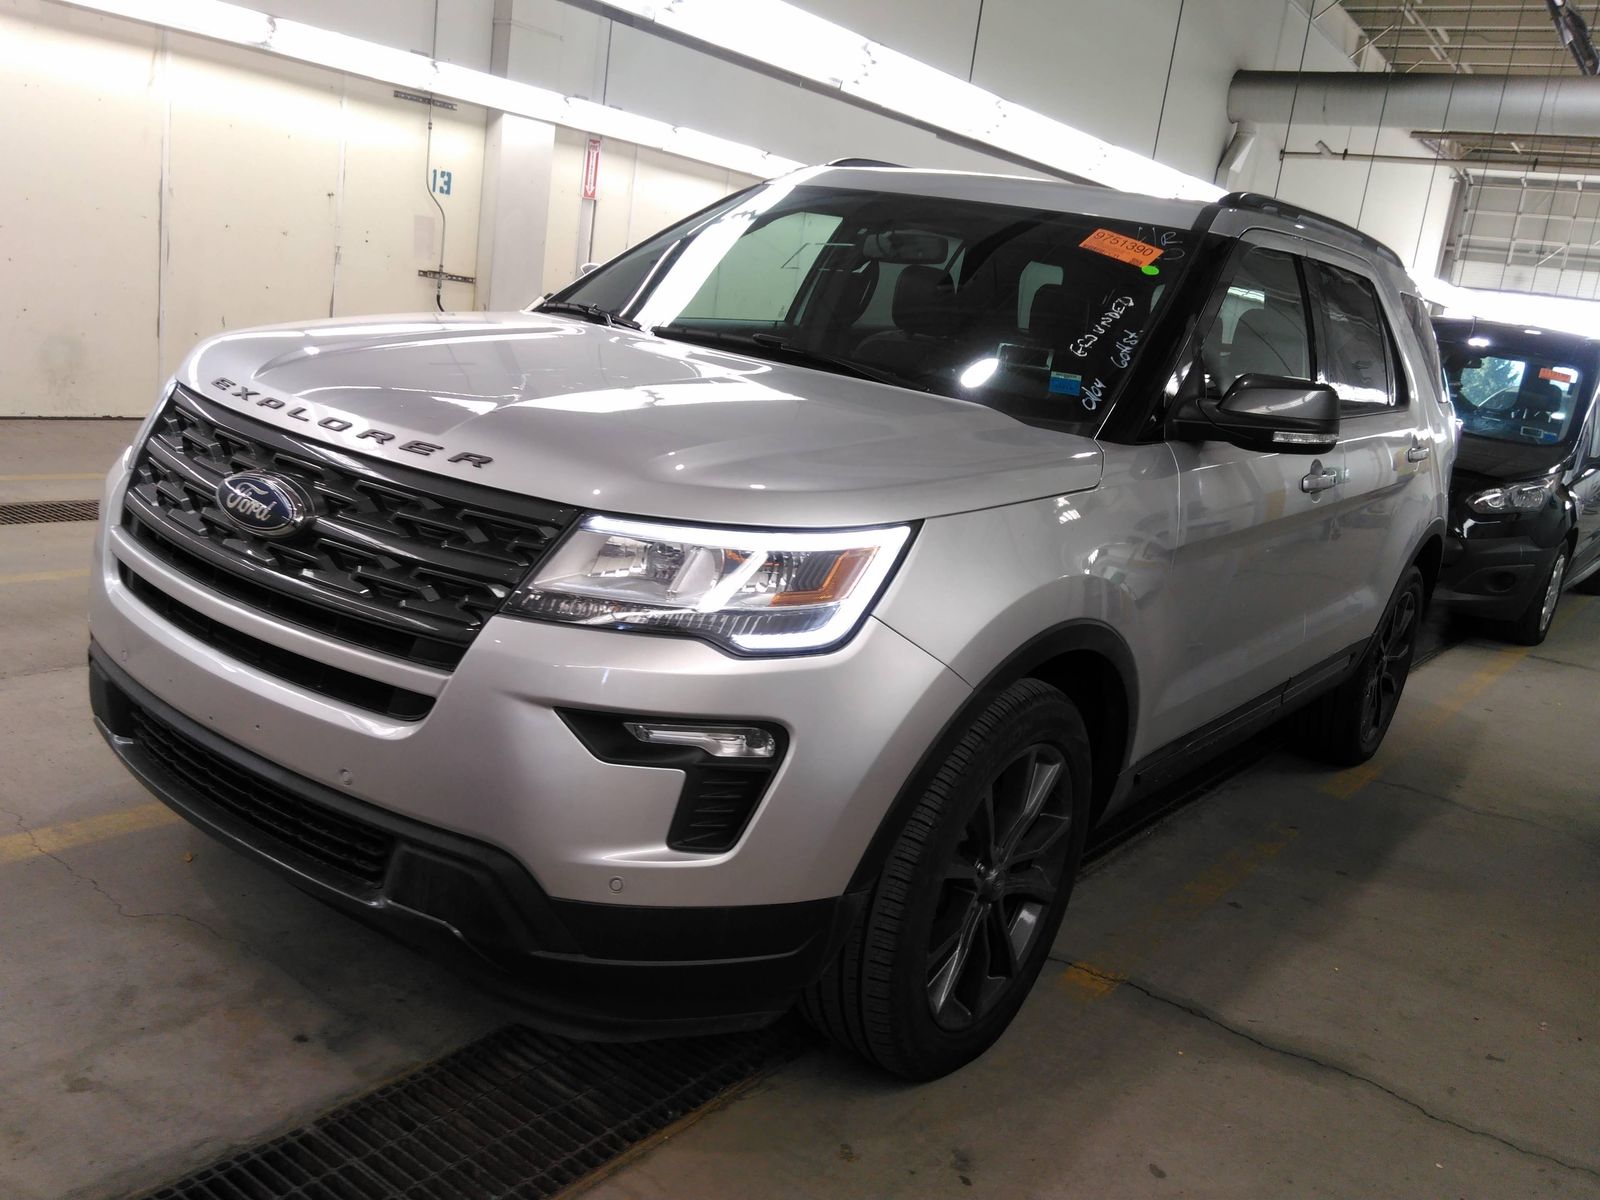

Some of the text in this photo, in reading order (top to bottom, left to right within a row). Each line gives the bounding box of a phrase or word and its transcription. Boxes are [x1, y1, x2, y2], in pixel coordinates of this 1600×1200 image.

[432, 168, 452, 195] 13
[1093, 231, 1155, 258] 9751390
[210, 376, 494, 469] EXPLORER
[226, 482, 279, 522] Ford
